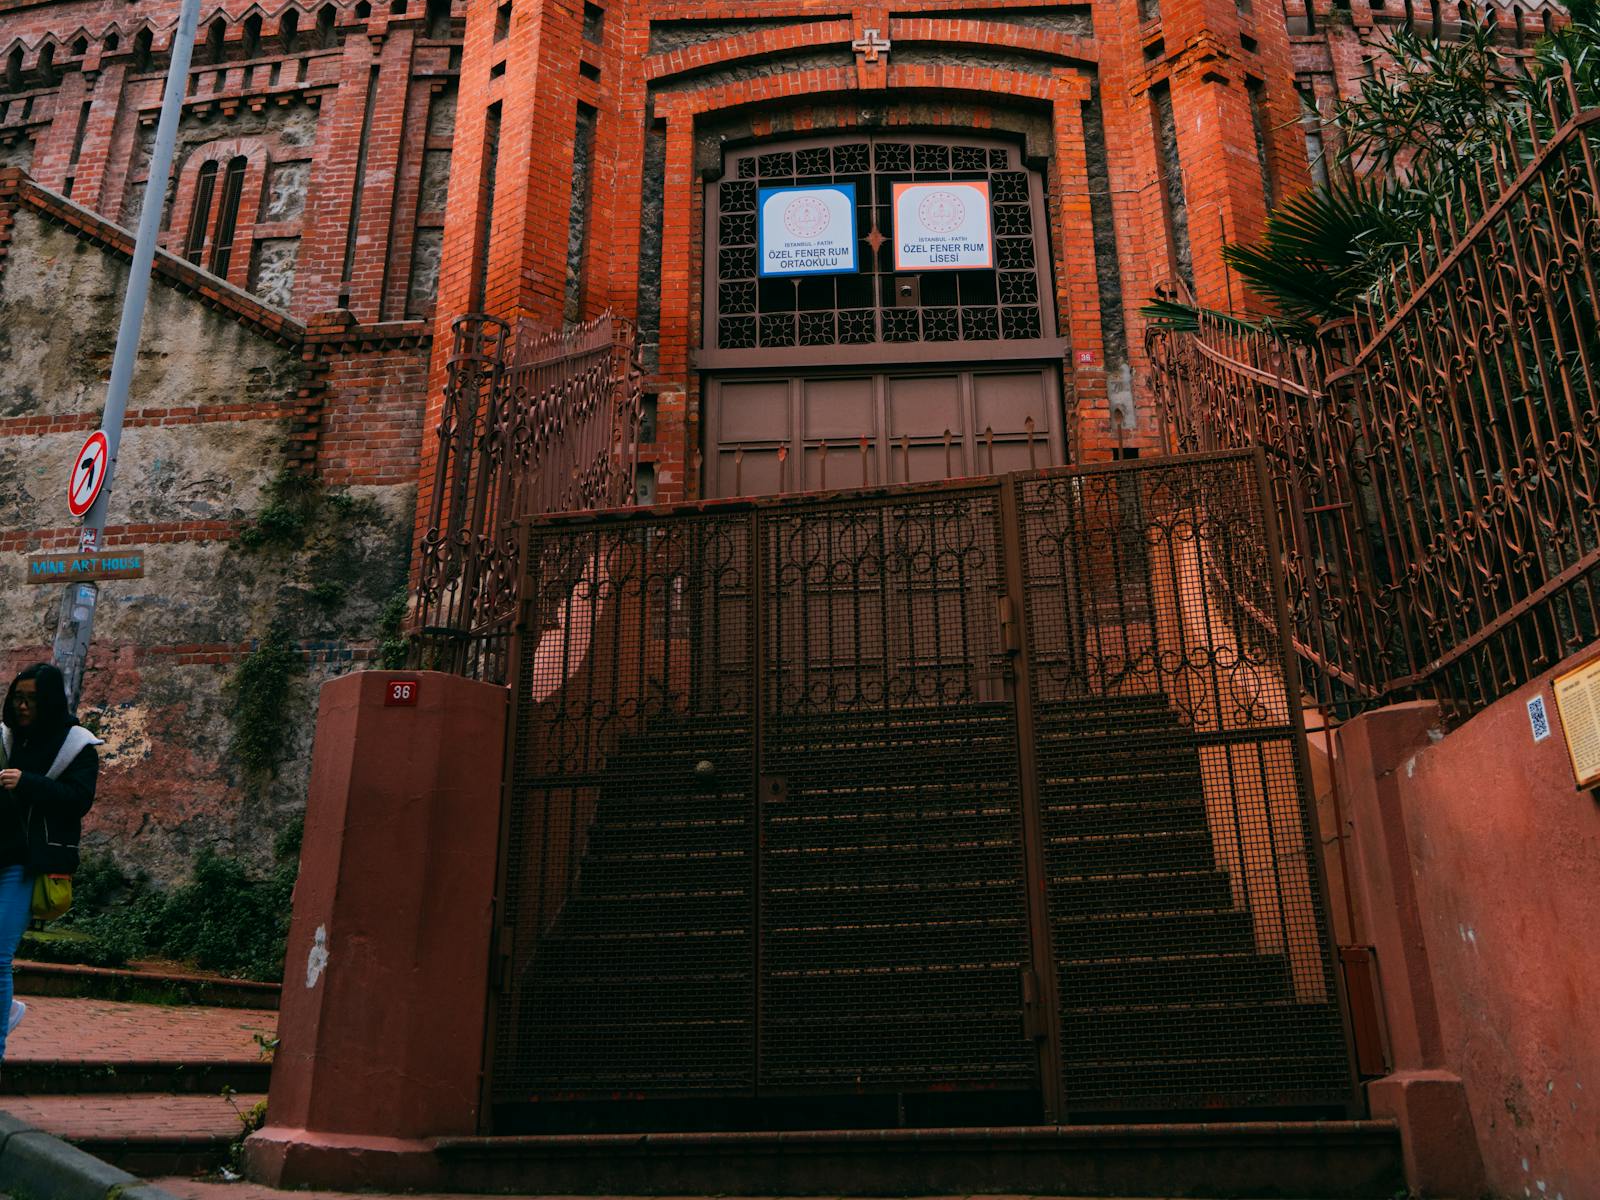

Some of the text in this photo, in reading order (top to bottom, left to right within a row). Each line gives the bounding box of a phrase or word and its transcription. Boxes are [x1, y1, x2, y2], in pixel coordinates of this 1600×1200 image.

[768, 247, 849, 260] ÖZEL FENER RUM
[903, 243, 985, 253] ÖZEL FENER RUM
[780, 257, 838, 269] ORTAOKULU
[929, 253, 959, 263] LİSESİ
[70, 558, 100, 572] ART
[101, 557, 141, 571] HOUSE
[393, 685, 411, 699] 36
